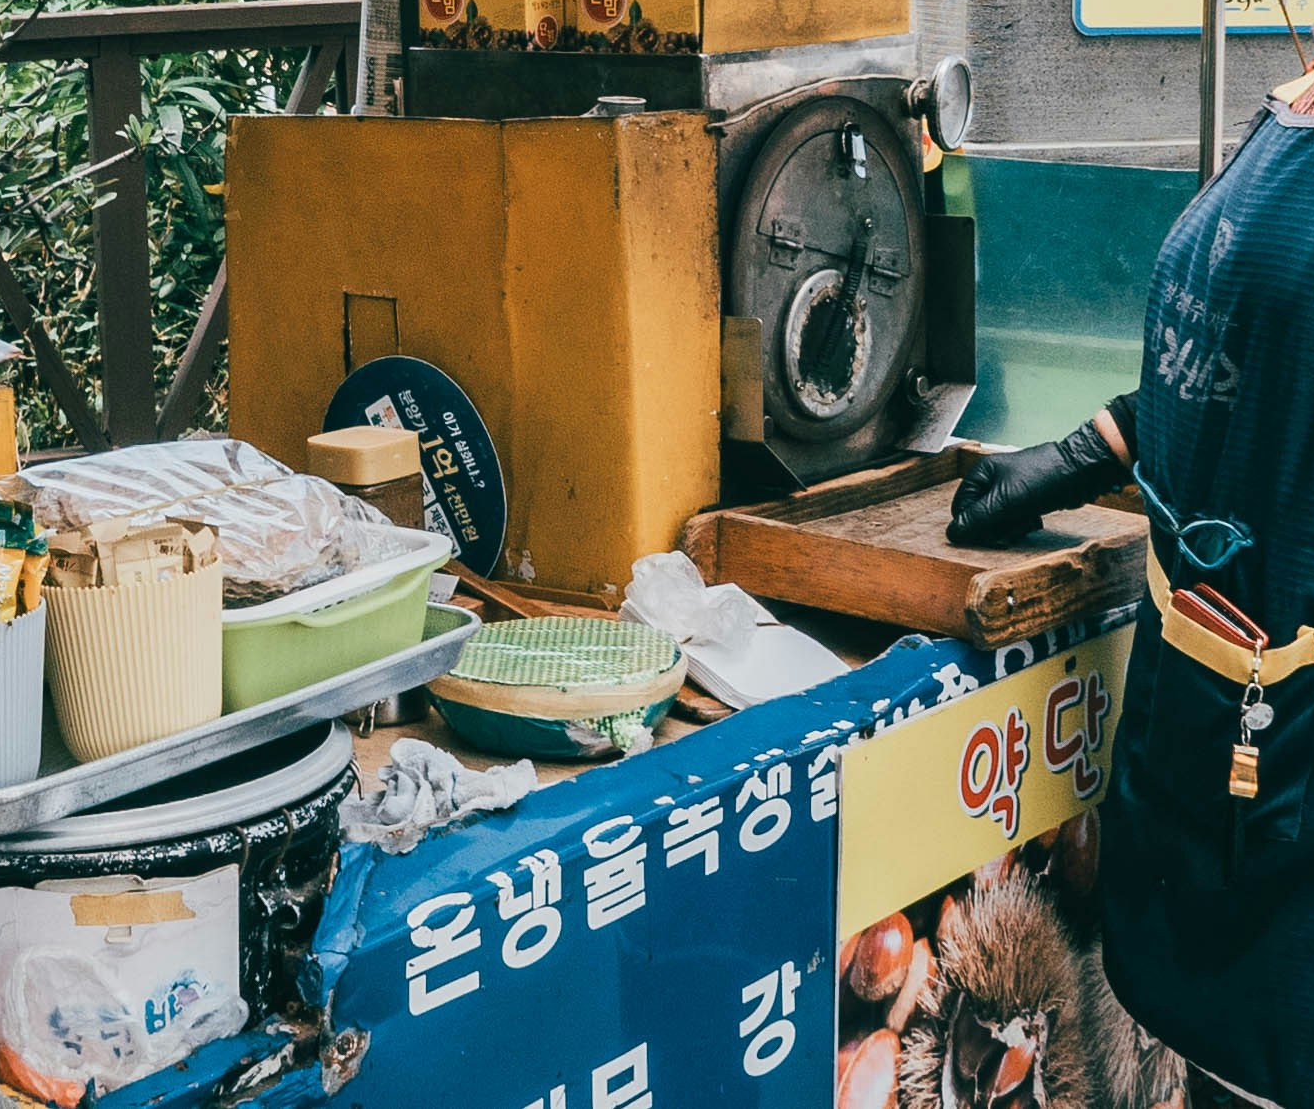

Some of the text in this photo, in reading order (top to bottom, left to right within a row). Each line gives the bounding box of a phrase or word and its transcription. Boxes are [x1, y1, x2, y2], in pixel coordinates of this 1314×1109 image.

[442, 411, 462, 438] 이거
[420, 434, 459, 480] 1억
[443, 482, 480, 543] 4천만원
